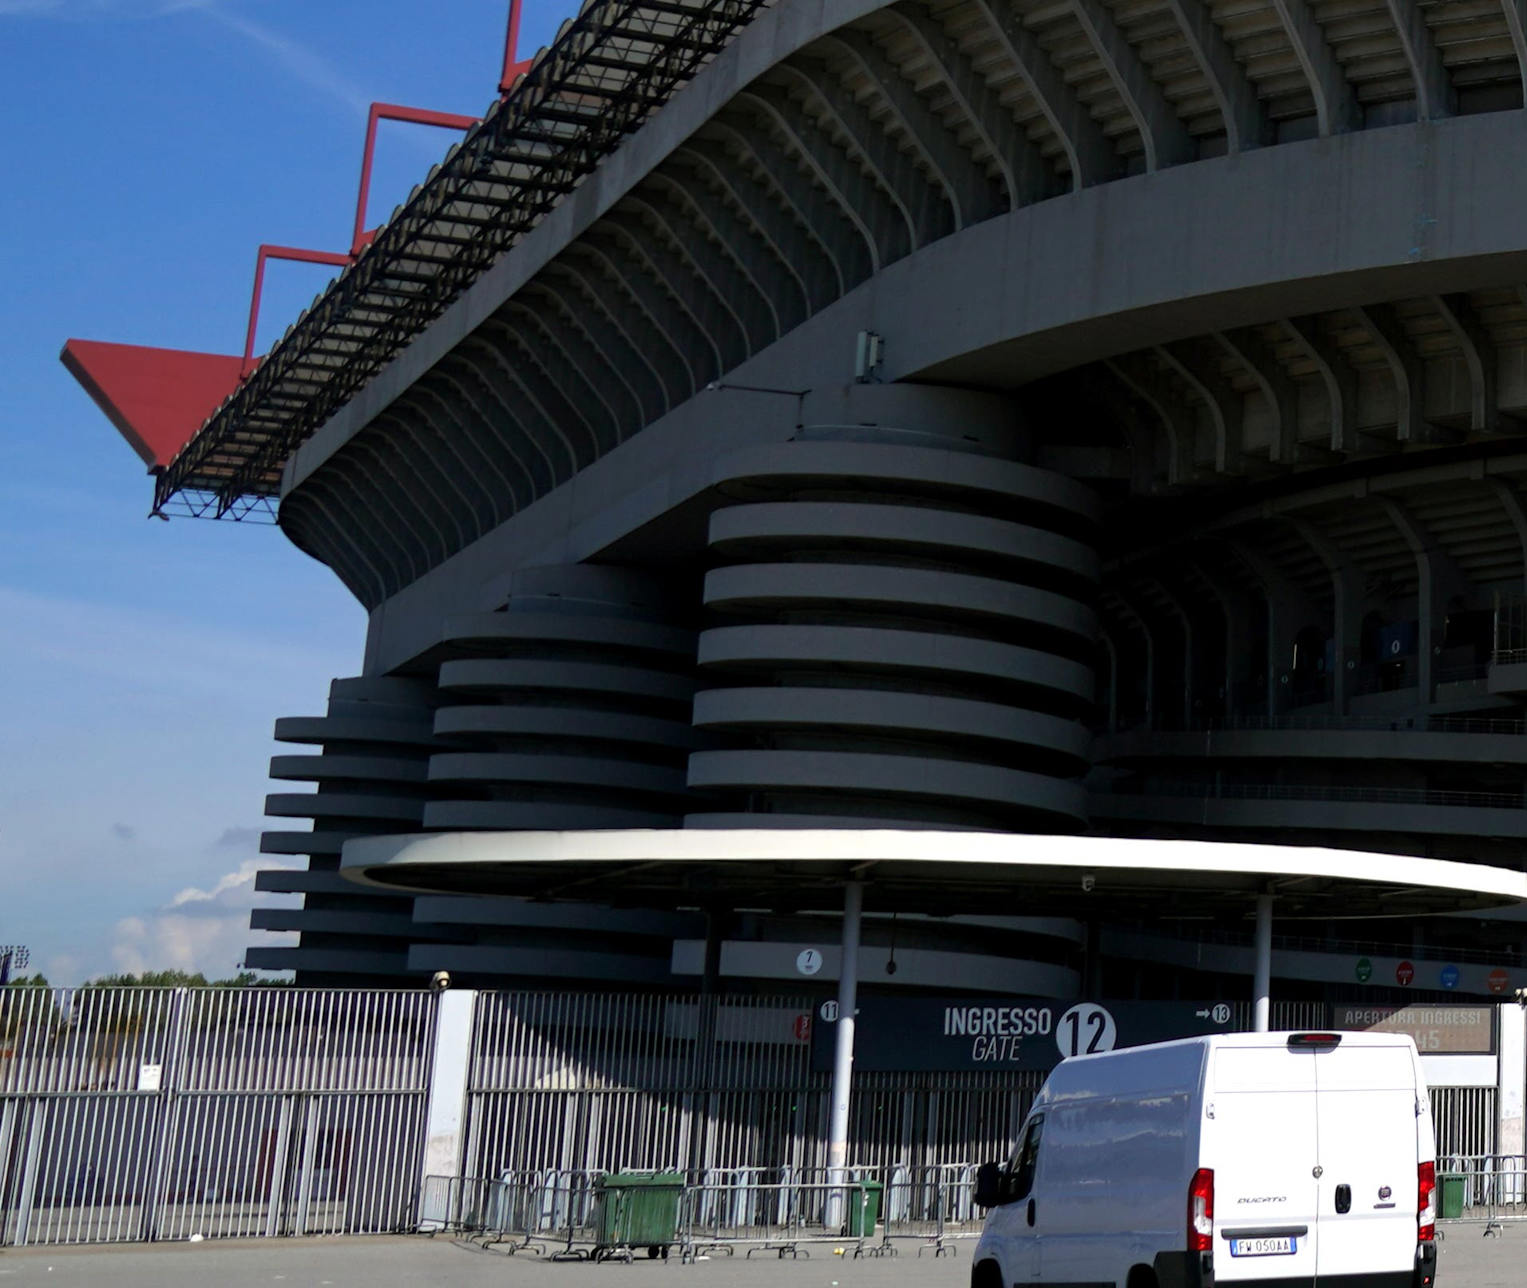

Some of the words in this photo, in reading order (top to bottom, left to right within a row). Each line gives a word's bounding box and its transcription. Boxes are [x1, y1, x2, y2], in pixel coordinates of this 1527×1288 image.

[1215, 1006, 1228, 1021] 13
[944, 1007, 1052, 1035] INGRESSO
[1065, 1011, 1107, 1057] 12
[972, 1036, 1023, 1061] GATE
[1237, 1196, 1287, 1204] DUCATO
[1256, 1239, 1289, 1252] 050AA
